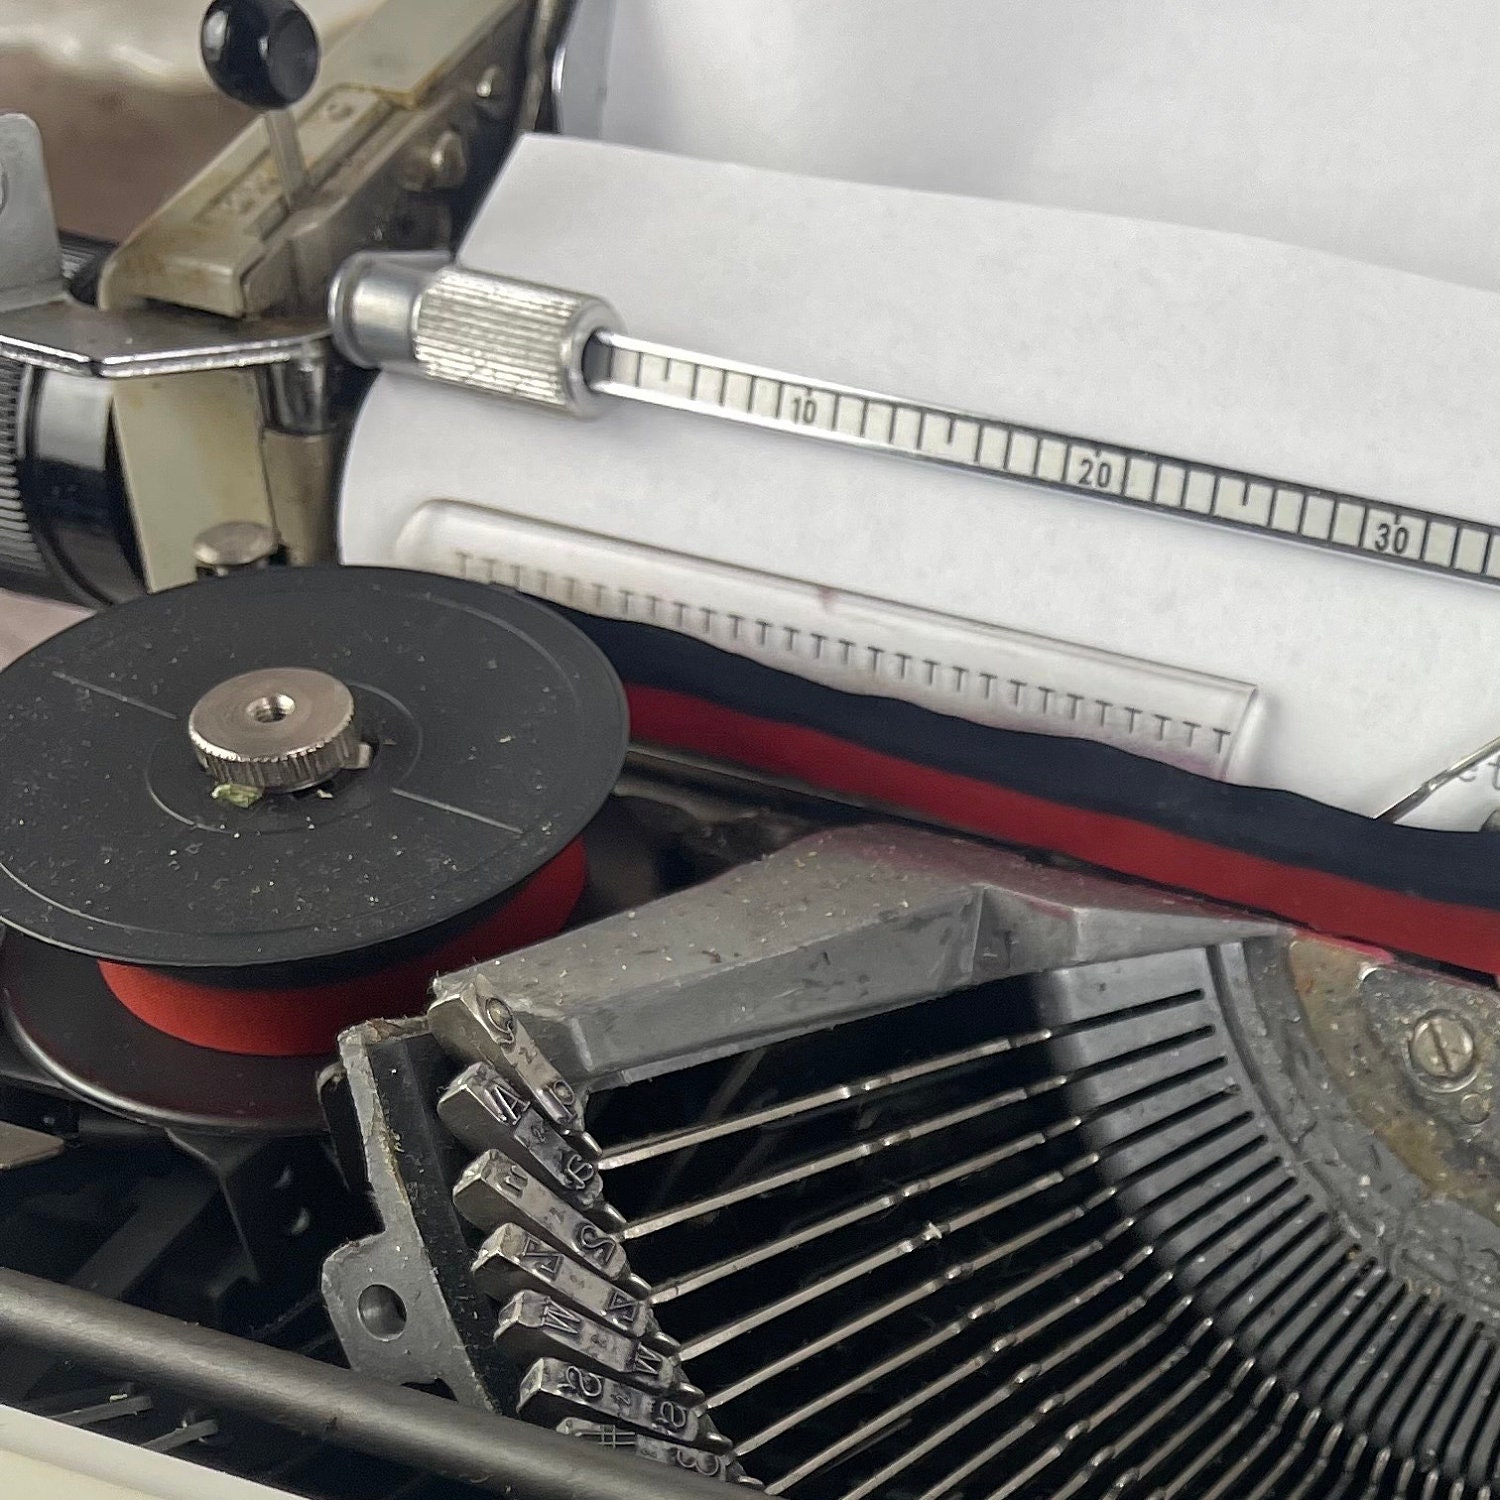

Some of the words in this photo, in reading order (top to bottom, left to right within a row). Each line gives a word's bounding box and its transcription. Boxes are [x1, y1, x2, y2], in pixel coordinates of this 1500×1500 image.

[792, 397, 818, 426] 10
[1079, 458, 1113, 489] 20
[1374, 523, 1410, 556] 30
